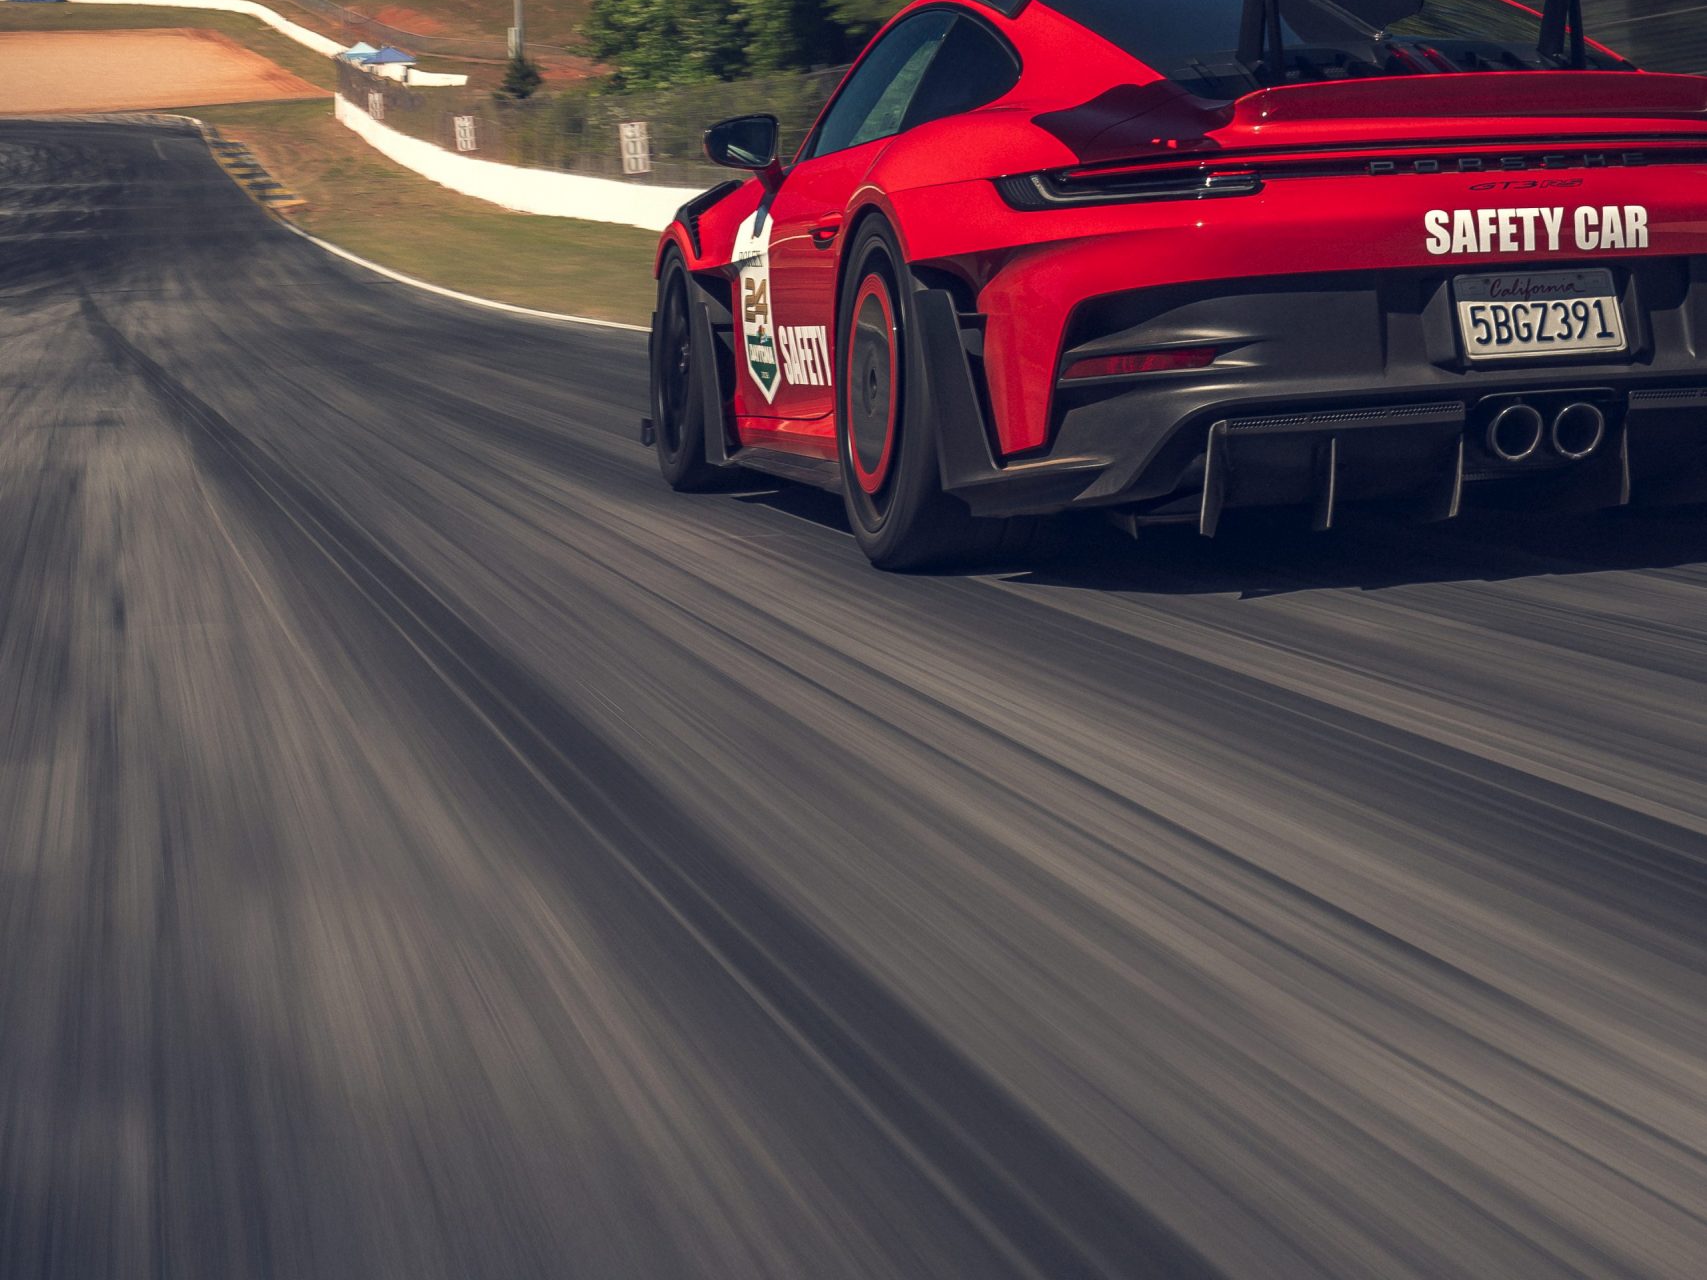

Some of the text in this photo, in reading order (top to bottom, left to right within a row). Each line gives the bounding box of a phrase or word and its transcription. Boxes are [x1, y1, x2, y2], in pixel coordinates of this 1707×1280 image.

[1369, 153, 1646, 174] PORSCHE
[1424, 205, 1648, 254] SAFETY CAR
[745, 278, 768, 324] 24
[1489, 278, 1585, 300] California
[1469, 299, 1615, 345] 5BGZ391
[778, 325, 832, 386] SAFETY
